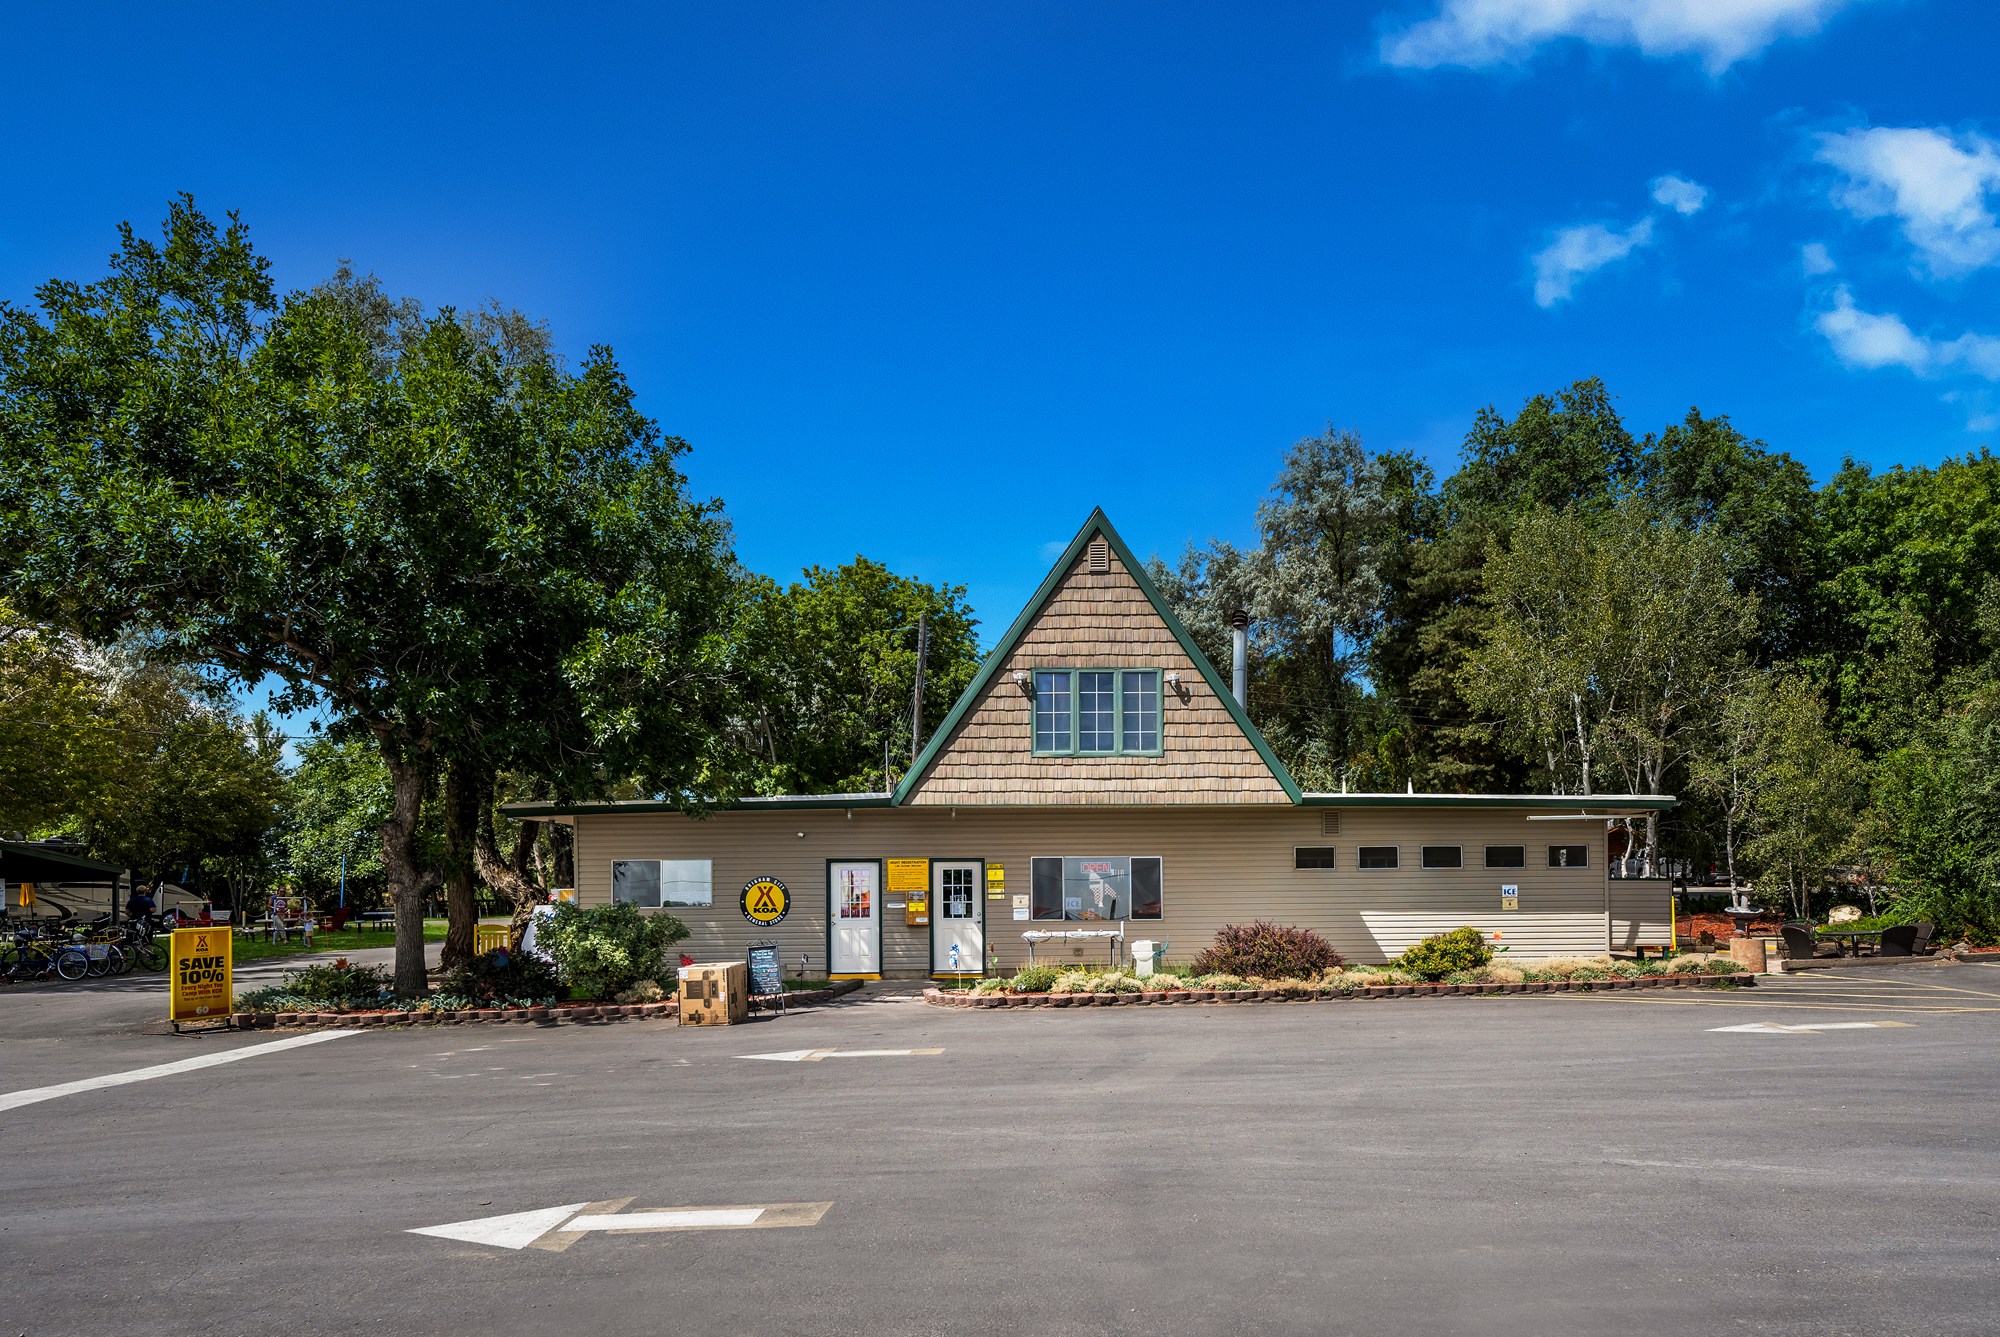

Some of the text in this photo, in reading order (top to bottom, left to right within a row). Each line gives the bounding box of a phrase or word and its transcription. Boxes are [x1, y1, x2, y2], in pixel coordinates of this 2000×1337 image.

[1081, 863, 1111, 873] OPEN
[1066, 900, 1080, 908] ICE
[180, 956, 224, 970] SAVE
[180, 969, 224, 985] 10%
